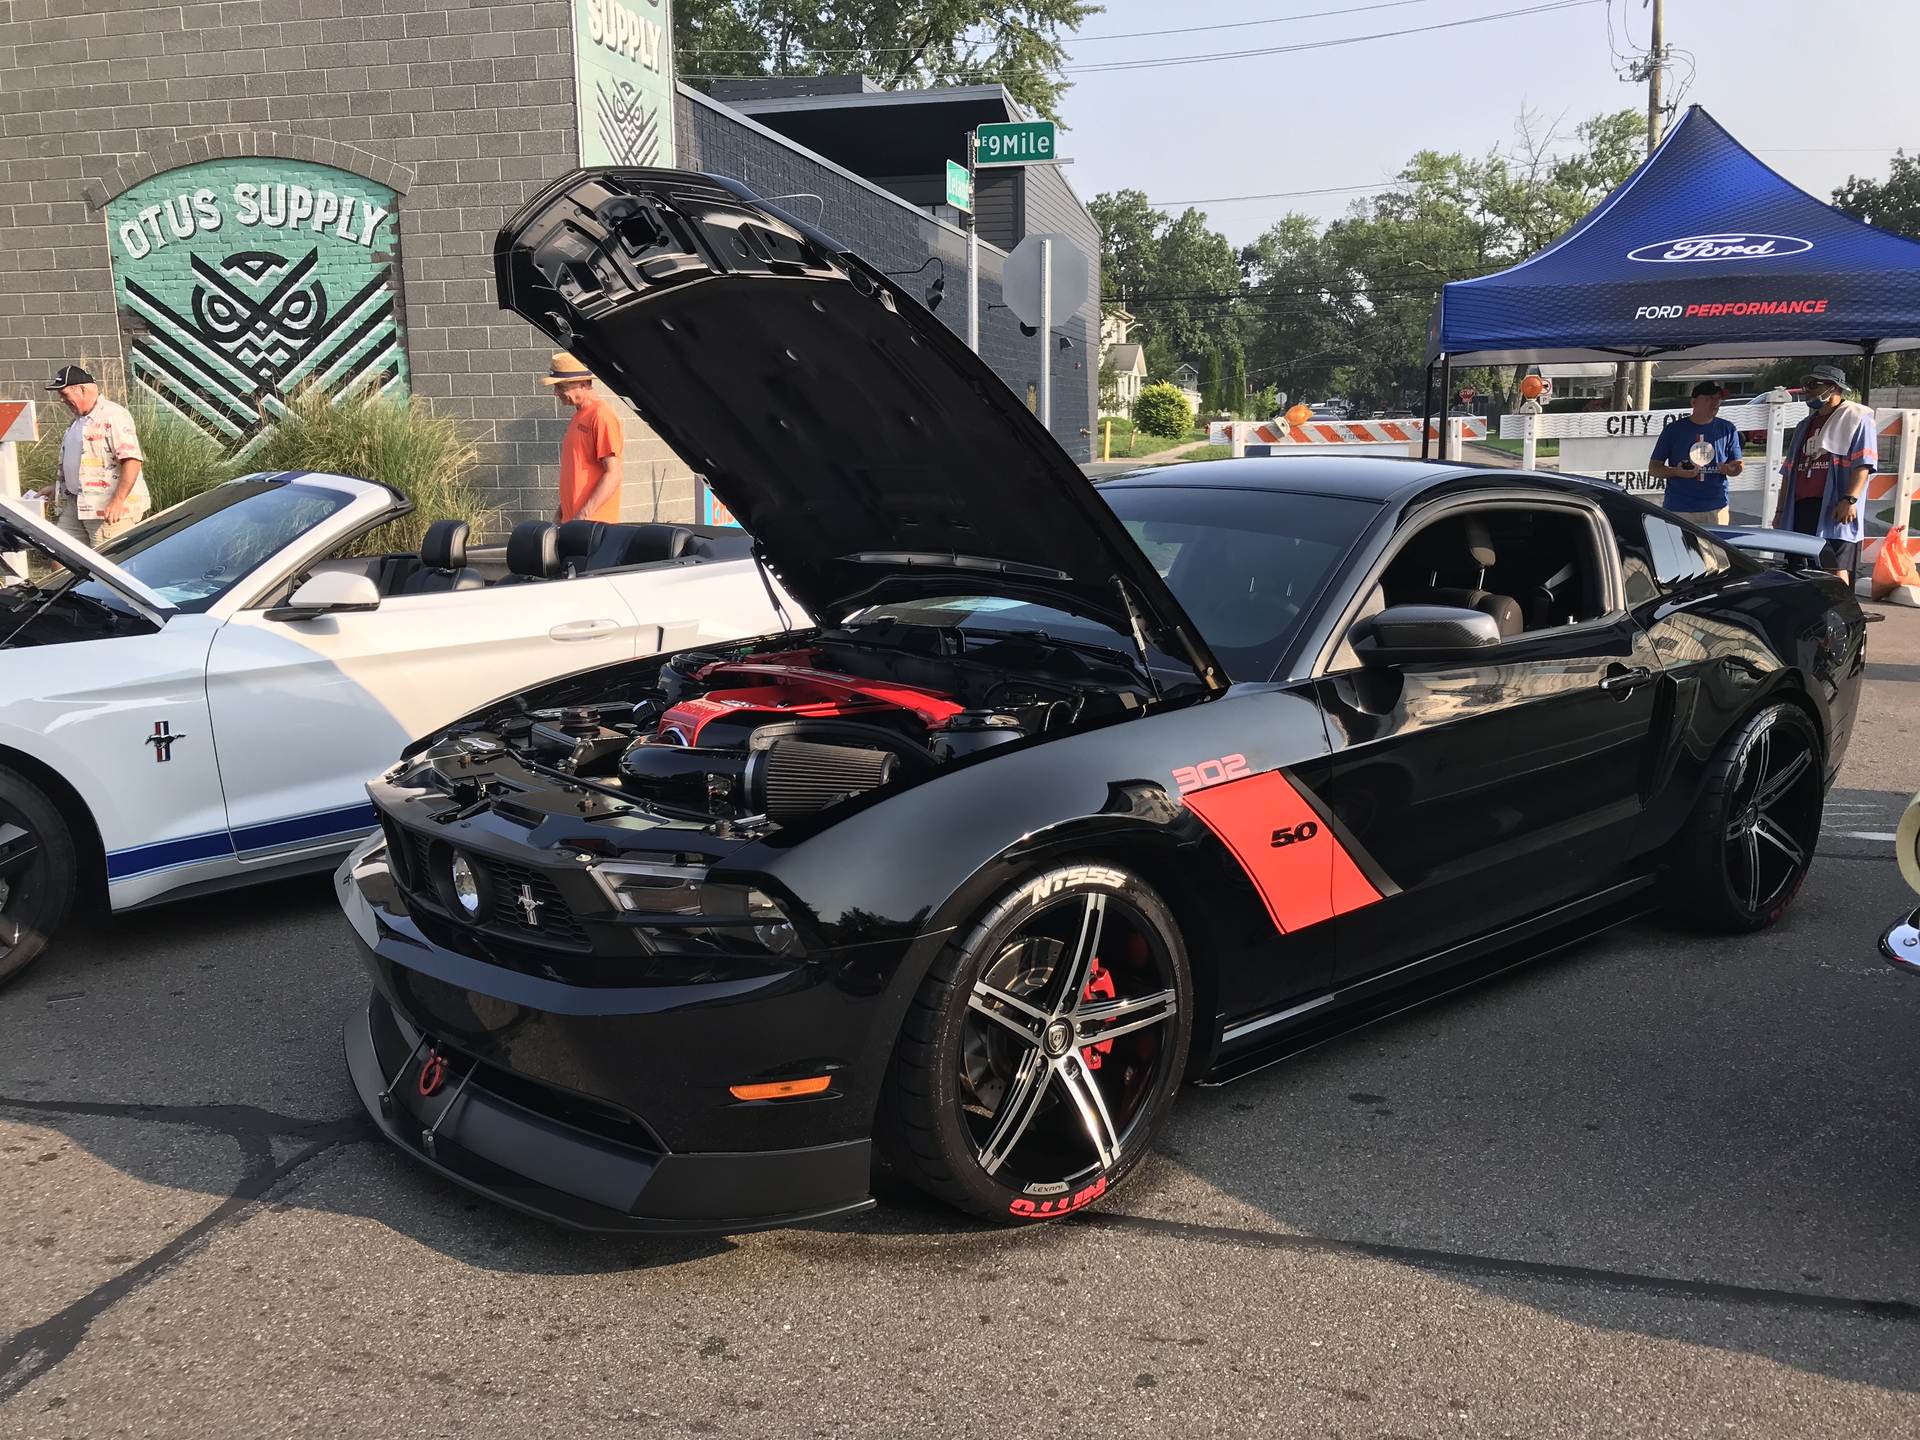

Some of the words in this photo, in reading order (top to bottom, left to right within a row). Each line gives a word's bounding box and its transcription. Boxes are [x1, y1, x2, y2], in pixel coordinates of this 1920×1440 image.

[587, 0, 661, 74] SUPPLY
[119, 188, 222, 259] OTUS
[233, 183, 389, 248] SUPPLY
[1664, 237, 1776, 260] Ford
[1635, 305, 1683, 320] FORD
[1685, 299, 1829, 318] PERFORMANCE
[1607, 414, 1652, 434] CITY
[1606, 472, 1667, 490] FERNDA
[1172, 753, 1250, 793] 302
